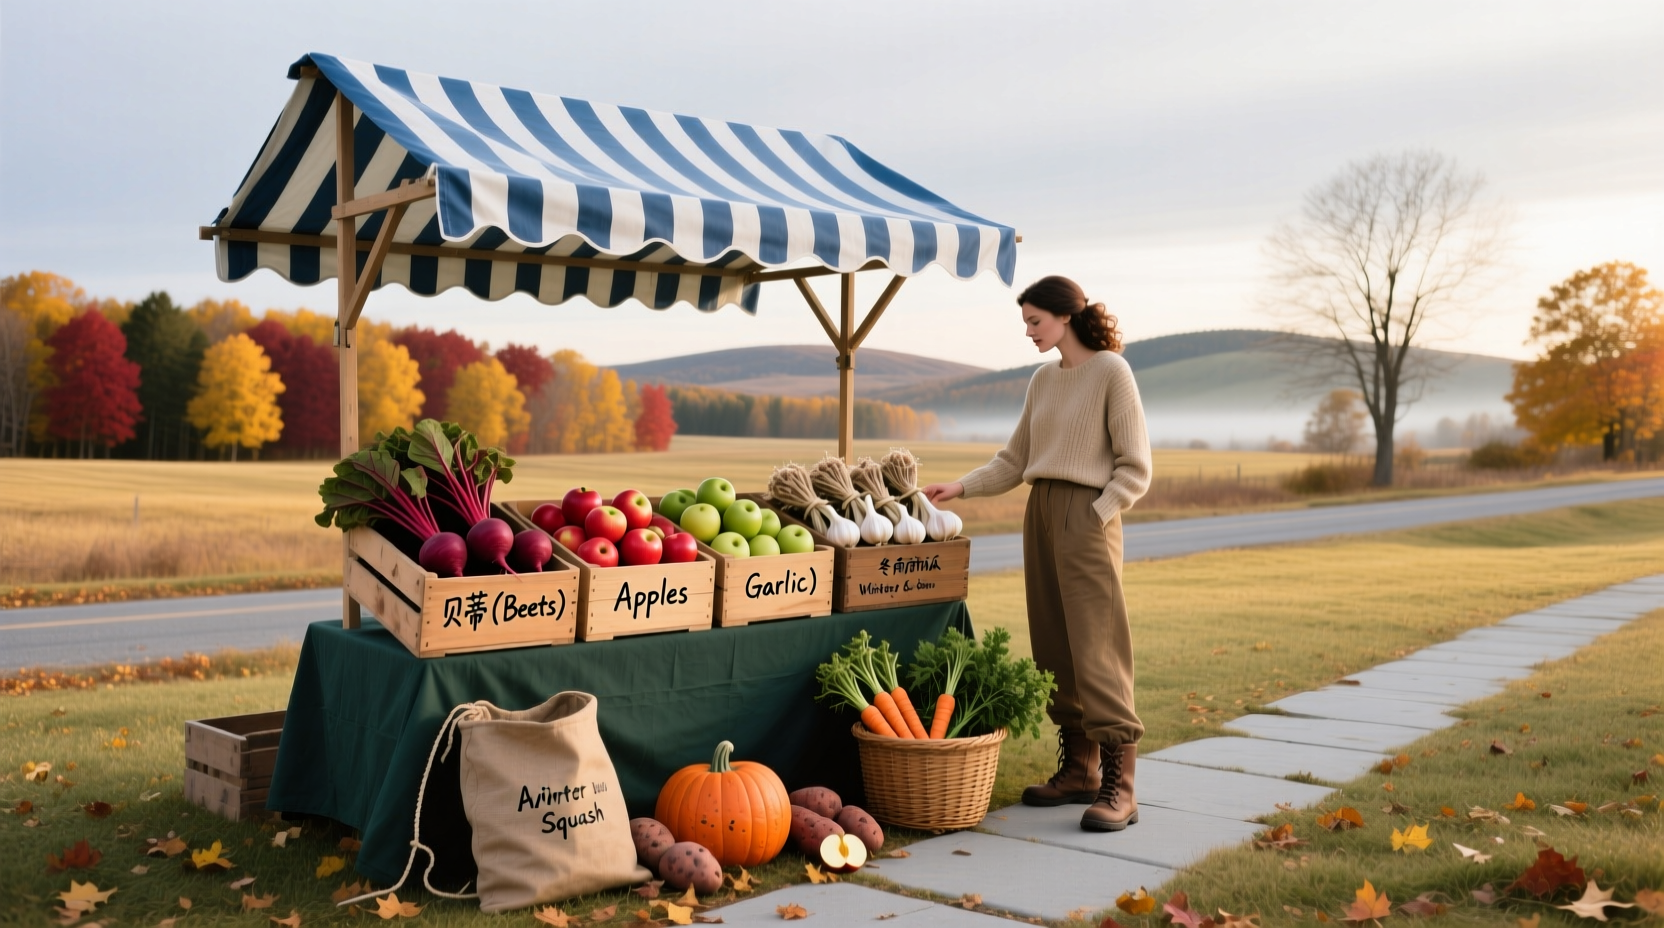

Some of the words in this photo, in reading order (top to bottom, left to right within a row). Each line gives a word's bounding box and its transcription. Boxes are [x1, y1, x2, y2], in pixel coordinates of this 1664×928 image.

[613, 577, 688, 620] Apples
[745, 566, 817, 600] Garlic)
[541, 801, 605, 841] Squash
